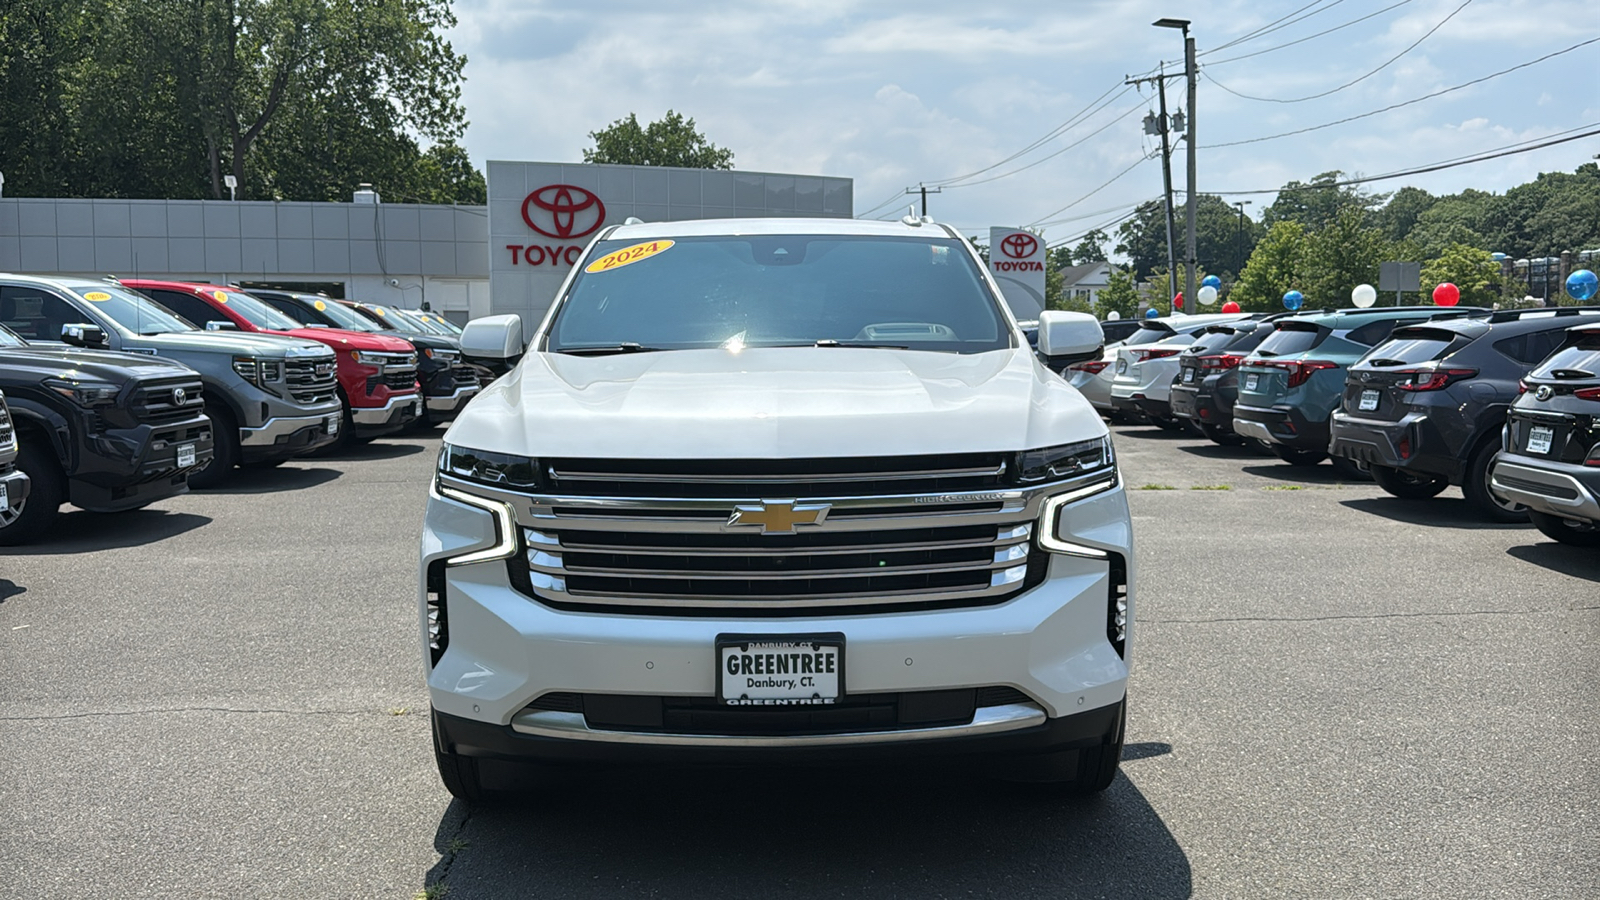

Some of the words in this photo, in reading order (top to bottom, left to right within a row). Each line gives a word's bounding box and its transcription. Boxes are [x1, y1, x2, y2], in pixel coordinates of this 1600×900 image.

[506, 245, 582, 266] TOYO
[603, 243, 659, 268] 2024
[994, 261, 1044, 272] TOYOTA
[727, 653, 835, 675] GREENTREE
[747, 677, 797, 690] Danbury,
[800, 676, 815, 687] CT.
[726, 698, 835, 706] GREENTREE
